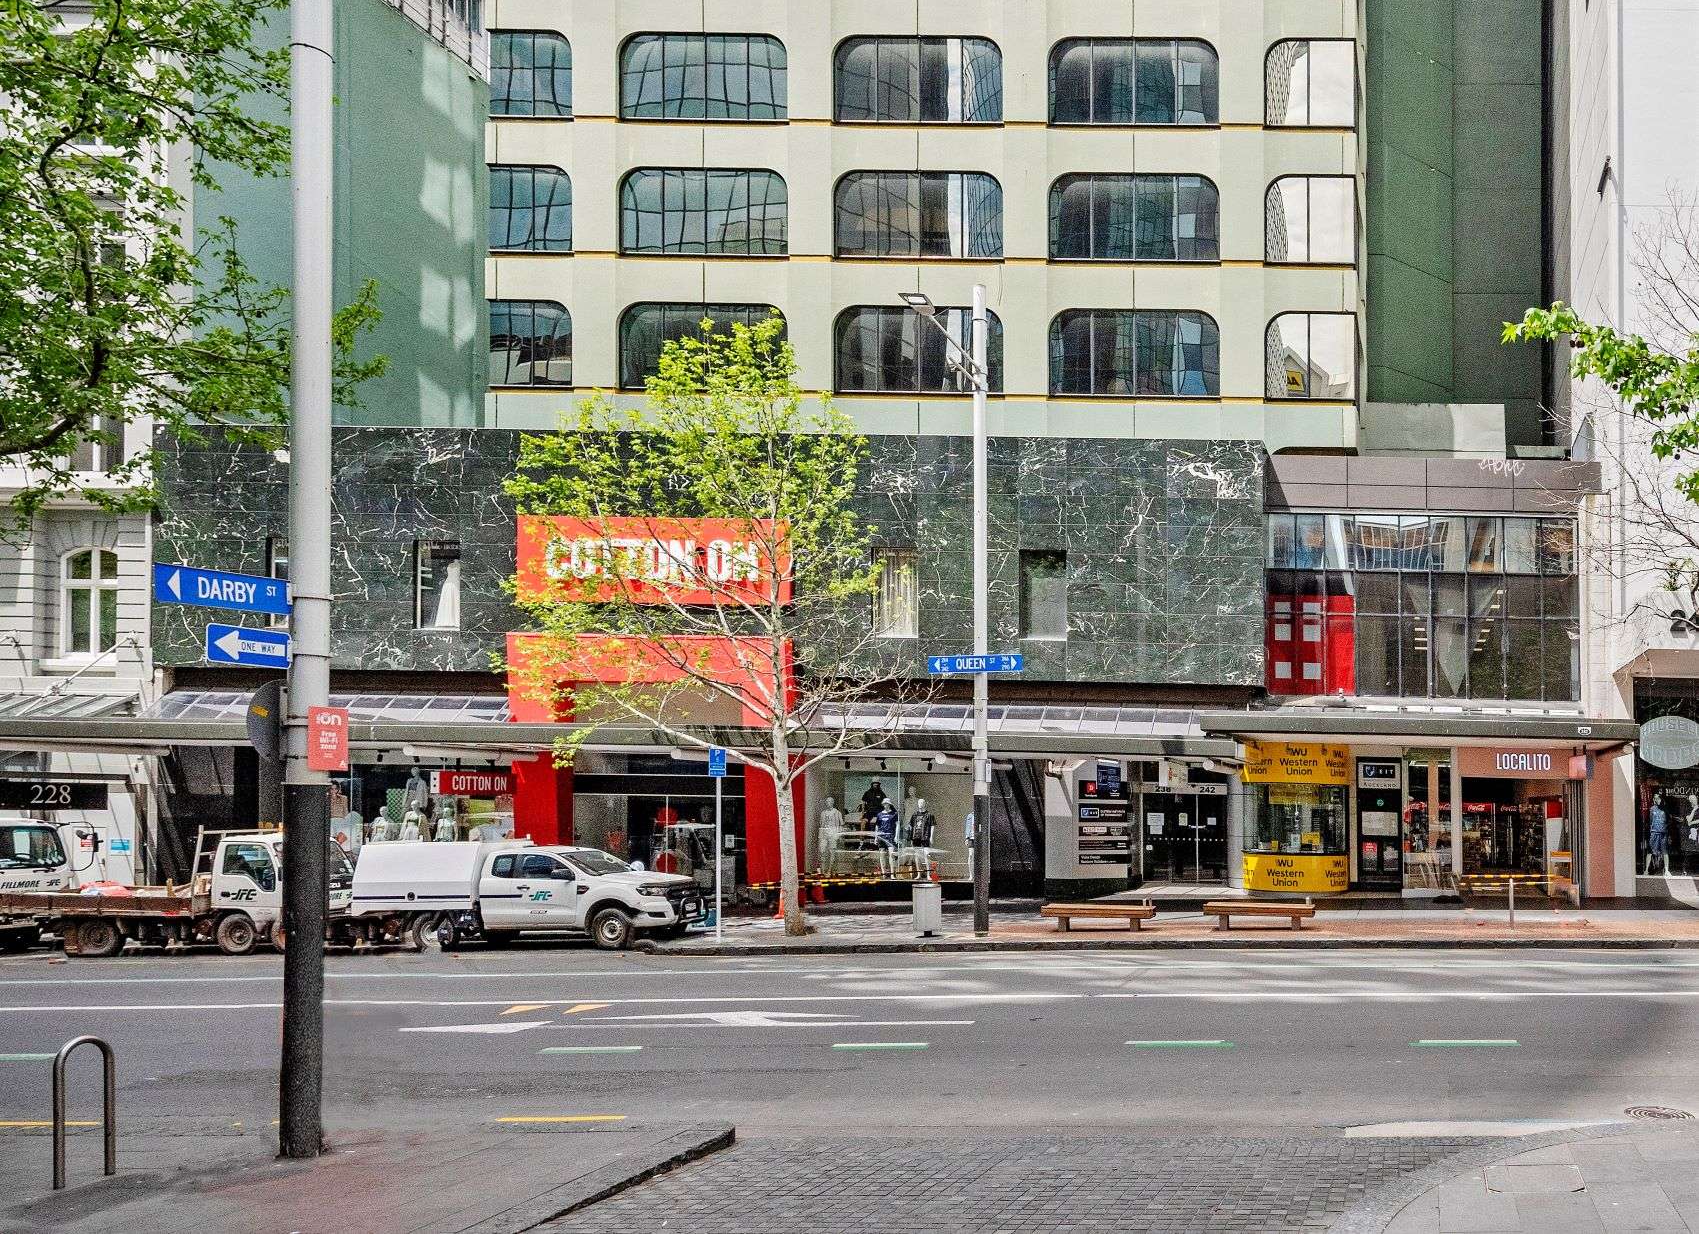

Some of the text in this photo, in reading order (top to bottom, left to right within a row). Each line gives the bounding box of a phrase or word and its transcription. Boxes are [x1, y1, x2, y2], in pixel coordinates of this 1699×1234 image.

[706, 538, 760, 583] ON
[197, 576, 278, 604] DARBY ST
[241, 641, 277, 654] ONE WAY
[955, 657, 987, 670] QUEEN
[1280, 758, 1318, 767] Western
[1496, 753, 1551, 771] LOCALITO
[1286, 767, 1313, 776] Union
[452, 775, 507, 791] COTTON ON
[30, 784, 72, 804] 228
[1199, 786, 1216, 794] 242
[1266, 869, 1305, 878] Western
[2, 880, 41, 889] FILLMORE
[1272, 878, 1299, 887] Union
